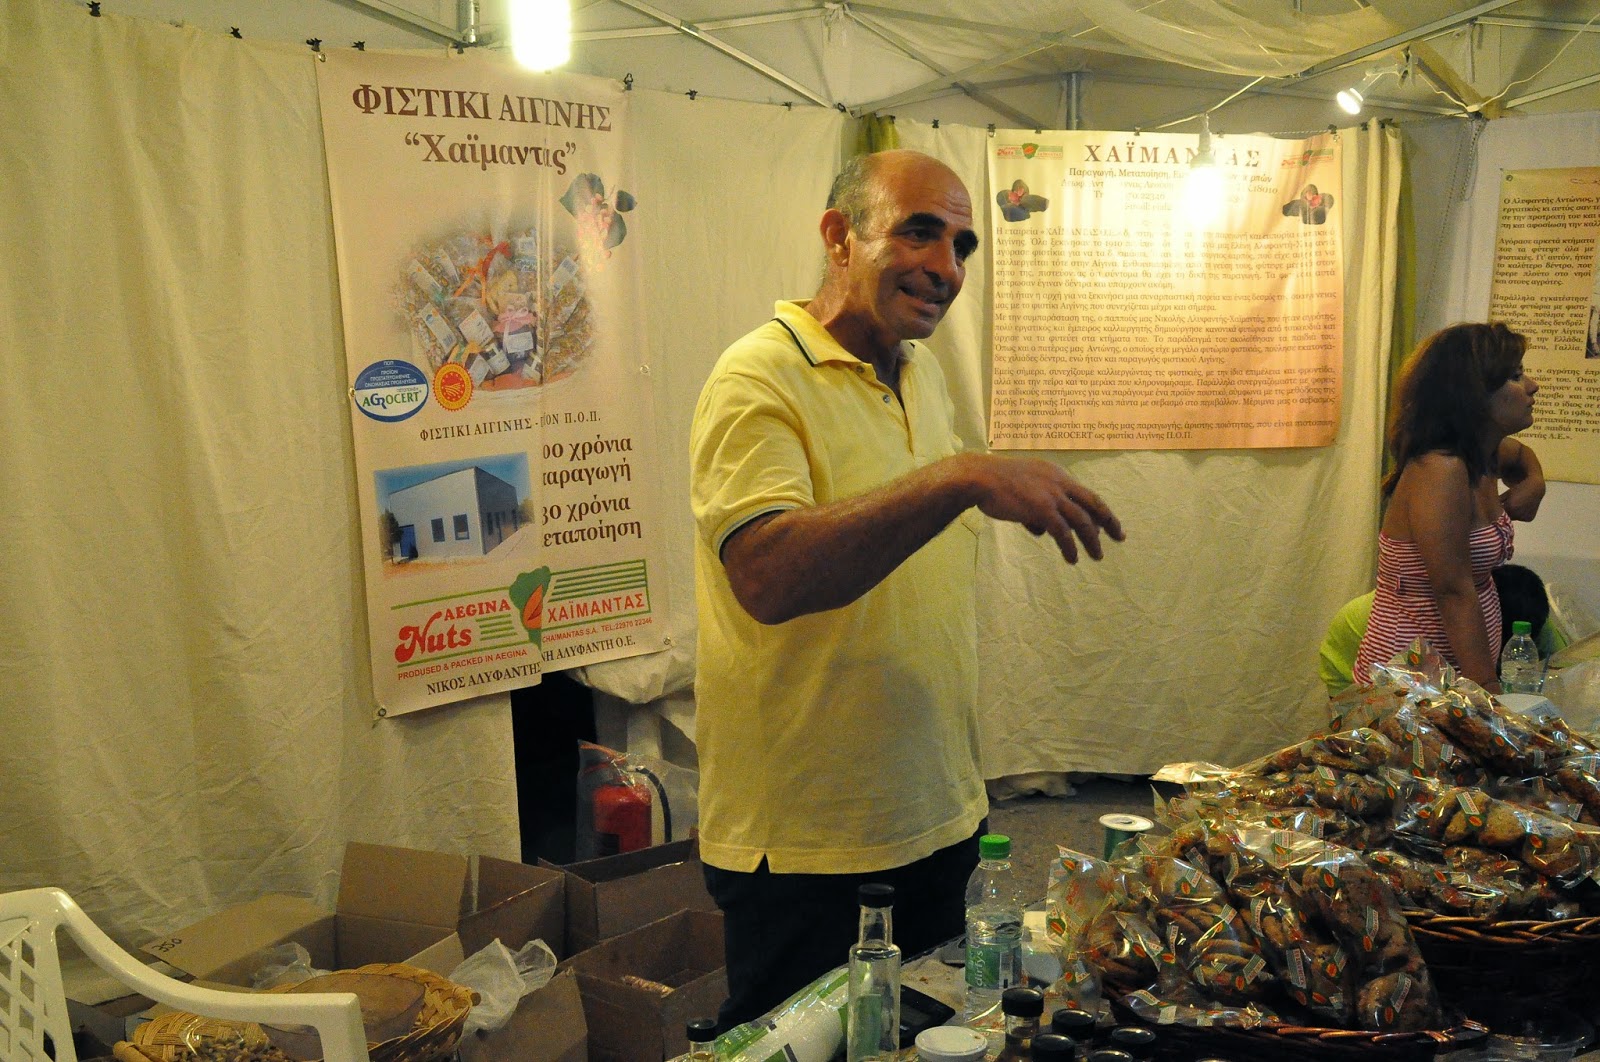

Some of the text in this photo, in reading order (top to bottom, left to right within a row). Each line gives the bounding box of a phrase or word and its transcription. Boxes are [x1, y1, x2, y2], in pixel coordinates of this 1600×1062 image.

[352, 84, 612, 132] ΦΙΣΤΙΚΙ ΑΙΓΙΝΗΣ
[1084, 141, 1260, 167] ΧΑΪΜΑΝΑΣ
[1060, 302, 1088, 312] Αιγίνης
[1106, 303, 1149, 312] συνεχίζεται
[1151, 303, 1171, 312] μέχρι
[420, 424, 471, 441] ΦΙΣΤΙΚΙ
[474, 418, 532, 436] ΑΙΓΙΝΗΣ
[564, 411, 601, 424] Π.Ο.Π.
[1045, 431, 1093, 439] AGROCERT
[569, 434, 632, 462] χρόνια
[566, 494, 630, 522] χρόνια
[444, 598, 512, 621] AEGINA
[548, 593, 645, 624] ΧΑΪΜΑΝΤΑΣ
[394, 611, 472, 663] Nuts
[556, 640, 614, 660] ΑΛΥΦΑΝΤΗ
[616, 635, 636, 648] Ο.Ε.
[398, 665, 442, 680] PRODUSED
[443, 664, 450, 672] &
[450, 656, 484, 670] PACKED
[486, 655, 494, 663] IN
[496, 648, 528, 661] AEGINA
[426, 661, 542, 696] ΝΙΚΟΣ ΑΛΥΦΑΝΤΗΣ
